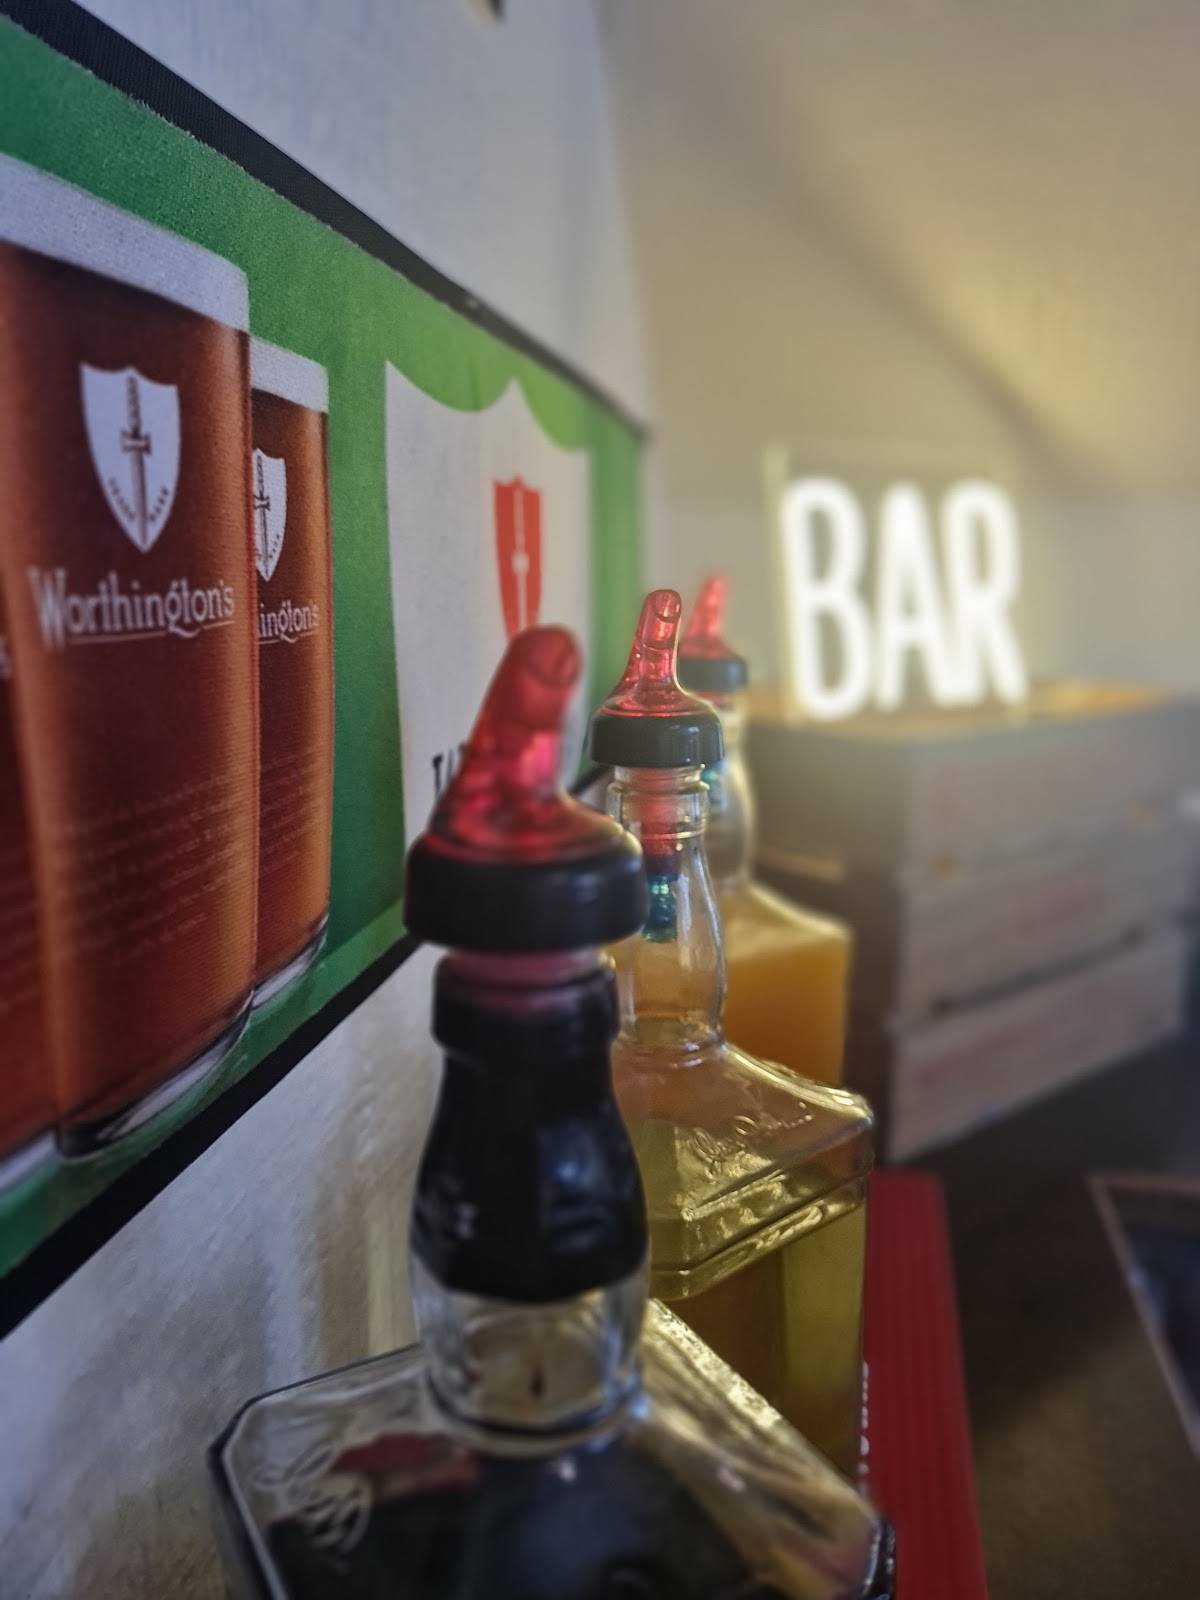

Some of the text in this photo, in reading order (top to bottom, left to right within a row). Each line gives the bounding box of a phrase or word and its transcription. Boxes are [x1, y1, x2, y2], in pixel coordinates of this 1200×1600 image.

[27, 565, 235, 650] Worthington's
[259, 600, 320, 643] ington's
[780, 477, 1027, 721] BAR
